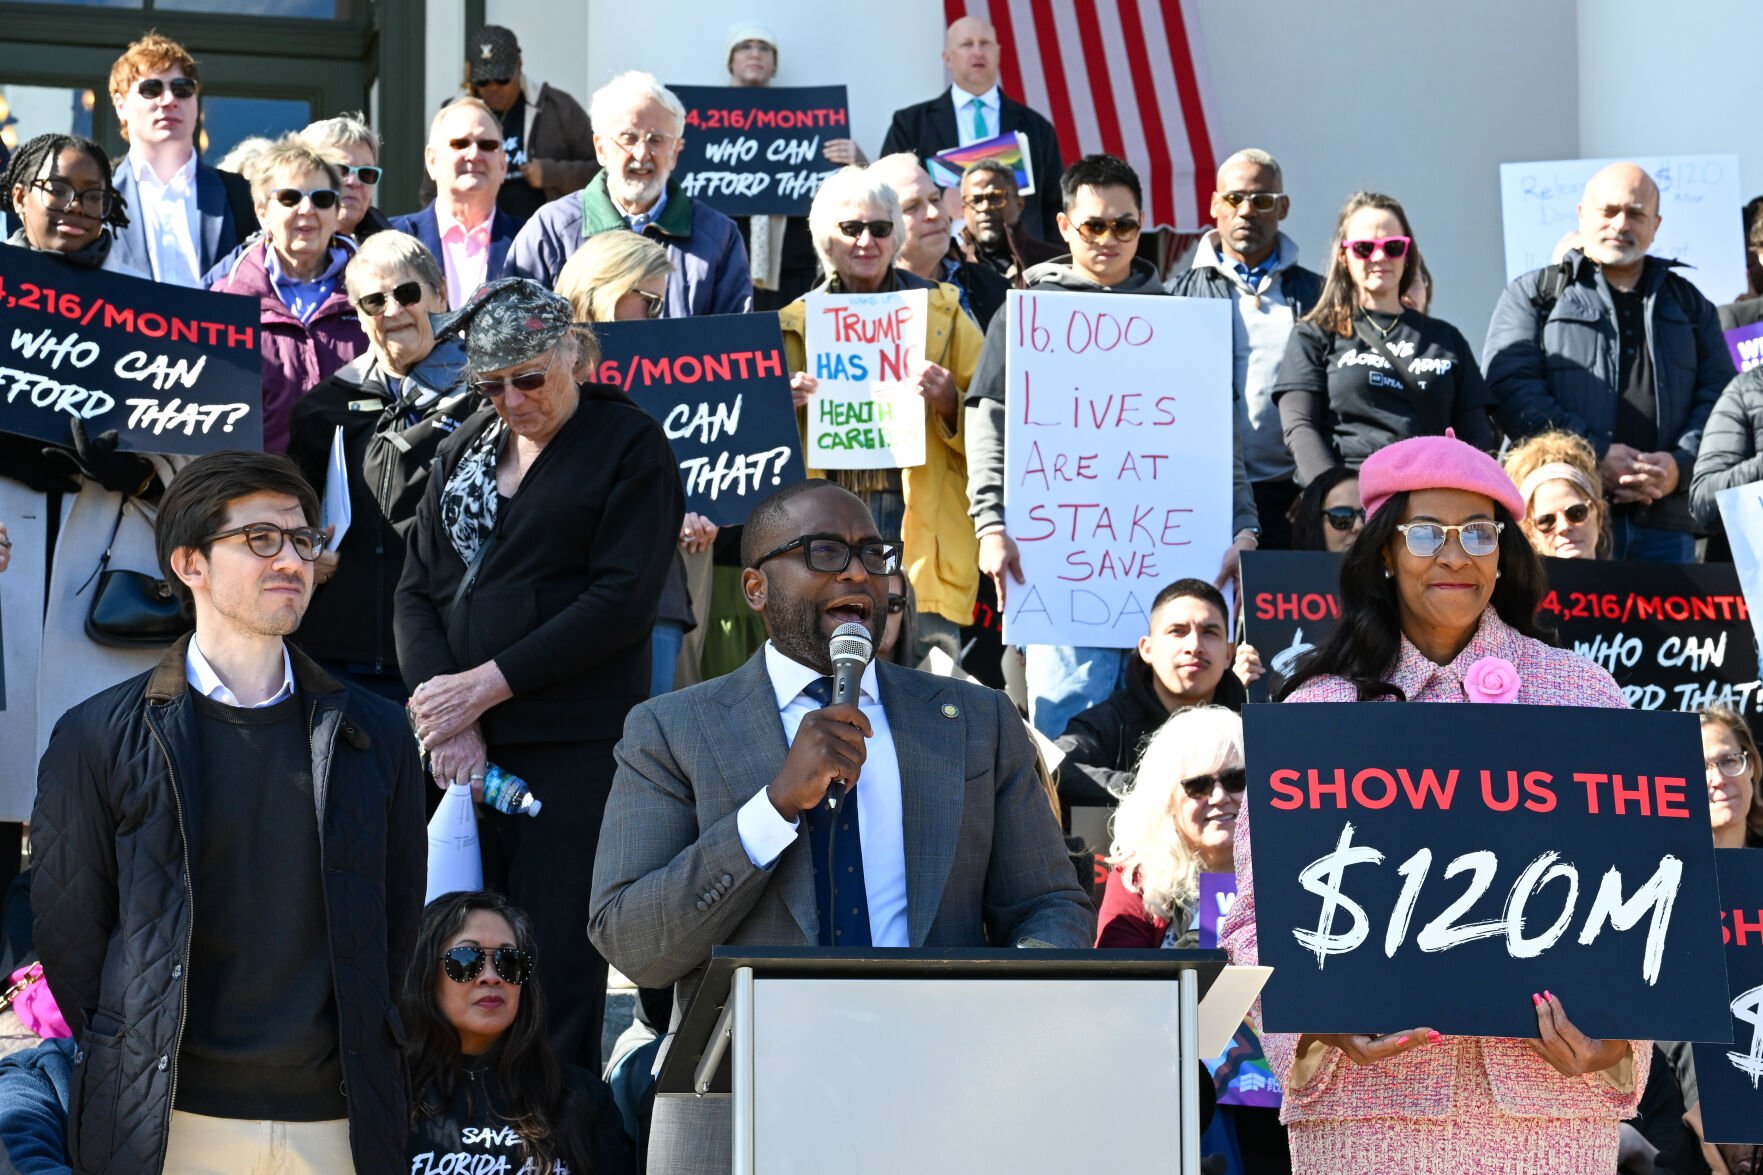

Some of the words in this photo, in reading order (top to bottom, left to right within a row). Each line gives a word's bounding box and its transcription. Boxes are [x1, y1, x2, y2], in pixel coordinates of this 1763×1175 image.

[705, 136, 759, 167] WHO
[766, 135, 820, 165] CAN
[680, 171, 770, 198] AFFORD
[823, 306, 914, 344] TRUMP
[10, 328, 101, 370] WHO
[114, 350, 207, 390] CAN
[816, 352, 869, 382] HAS
[125, 398, 250, 436] THAT?
[663, 393, 743, 444] CAN
[820, 398, 893, 426] HEALTH
[680, 446, 792, 501] THAT?
[1020, 440, 1099, 491] ARE
[1117, 450, 1169, 480] AT
[1015, 504, 1194, 548] STAKE
[1057, 550, 1161, 582] SAVE
[1574, 631, 1643, 674] WHO
[1656, 630, 1728, 672] CAN
[1269, 768, 1460, 811] SHOW
[1480, 770, 1557, 813] US
[1573, 773, 1691, 819] THE
[1291, 820, 1683, 988] $120M
[461, 1125, 523, 1149] SAVE
[411, 1150, 512, 1175] FLORIDA
